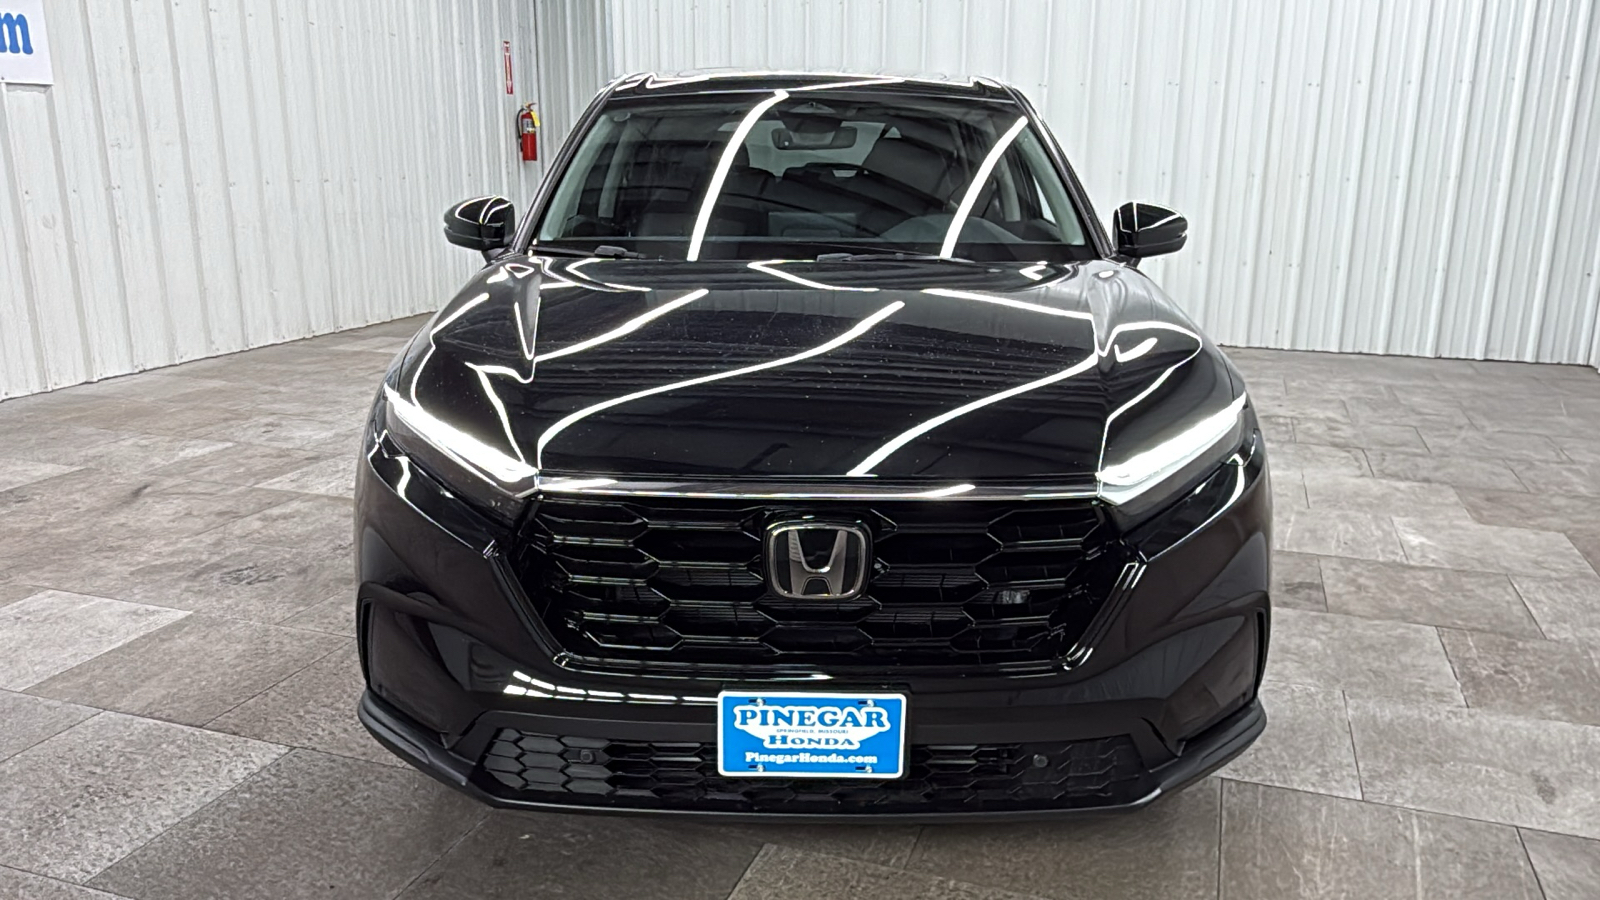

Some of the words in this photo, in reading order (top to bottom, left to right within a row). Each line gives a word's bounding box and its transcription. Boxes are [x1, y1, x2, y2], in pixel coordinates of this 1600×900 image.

[740, 709, 887, 728] PINEGAR
[768, 734, 855, 746] HONDA
[745, 752, 877, 764] PinegarHonda.com
